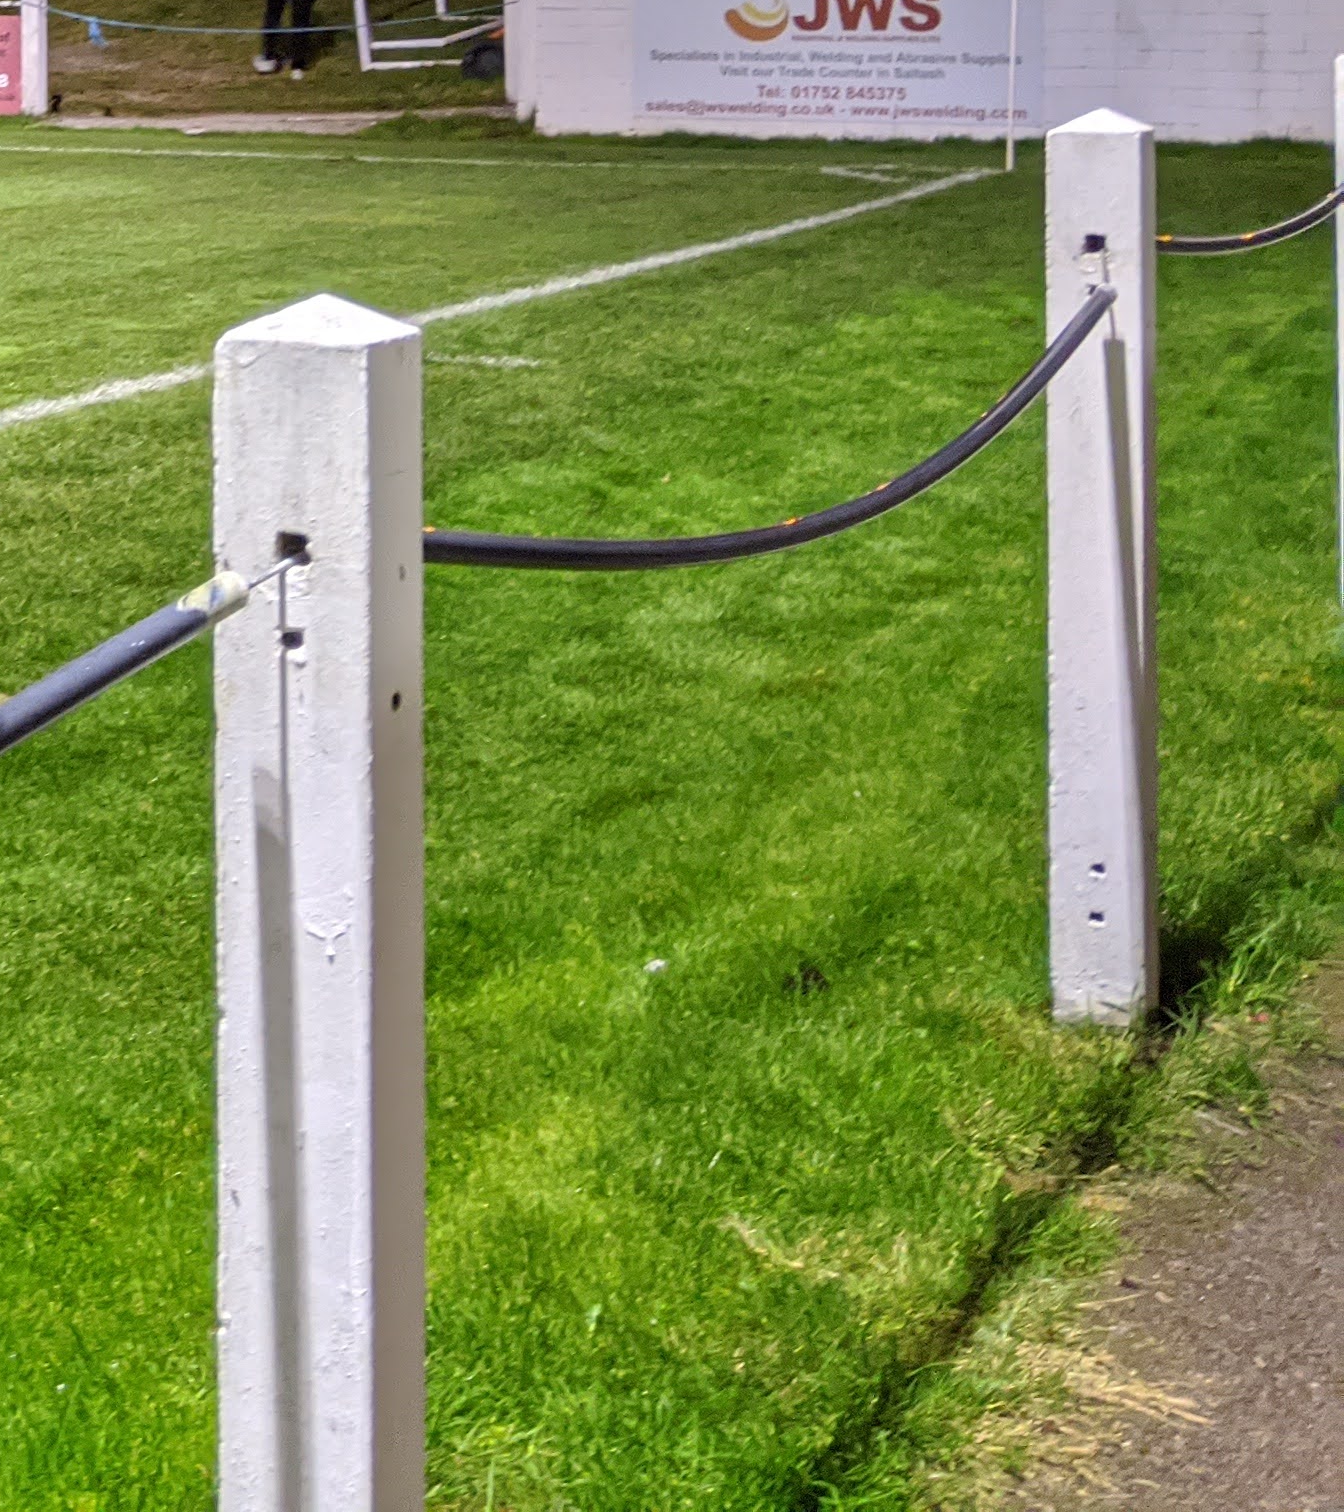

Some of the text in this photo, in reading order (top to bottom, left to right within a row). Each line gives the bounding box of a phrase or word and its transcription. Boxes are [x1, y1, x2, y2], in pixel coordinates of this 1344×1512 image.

[867, 52, 892, 64] and
[961, 52, 1023, 67] Supplis
[720, 65, 749, 77] Visit
[751, 67, 775, 77] our
[777, 65, 815, 78] Trade
[818, 66, 873, 78] Counter
[757, 85, 908, 101] Tel: 01752 845375
